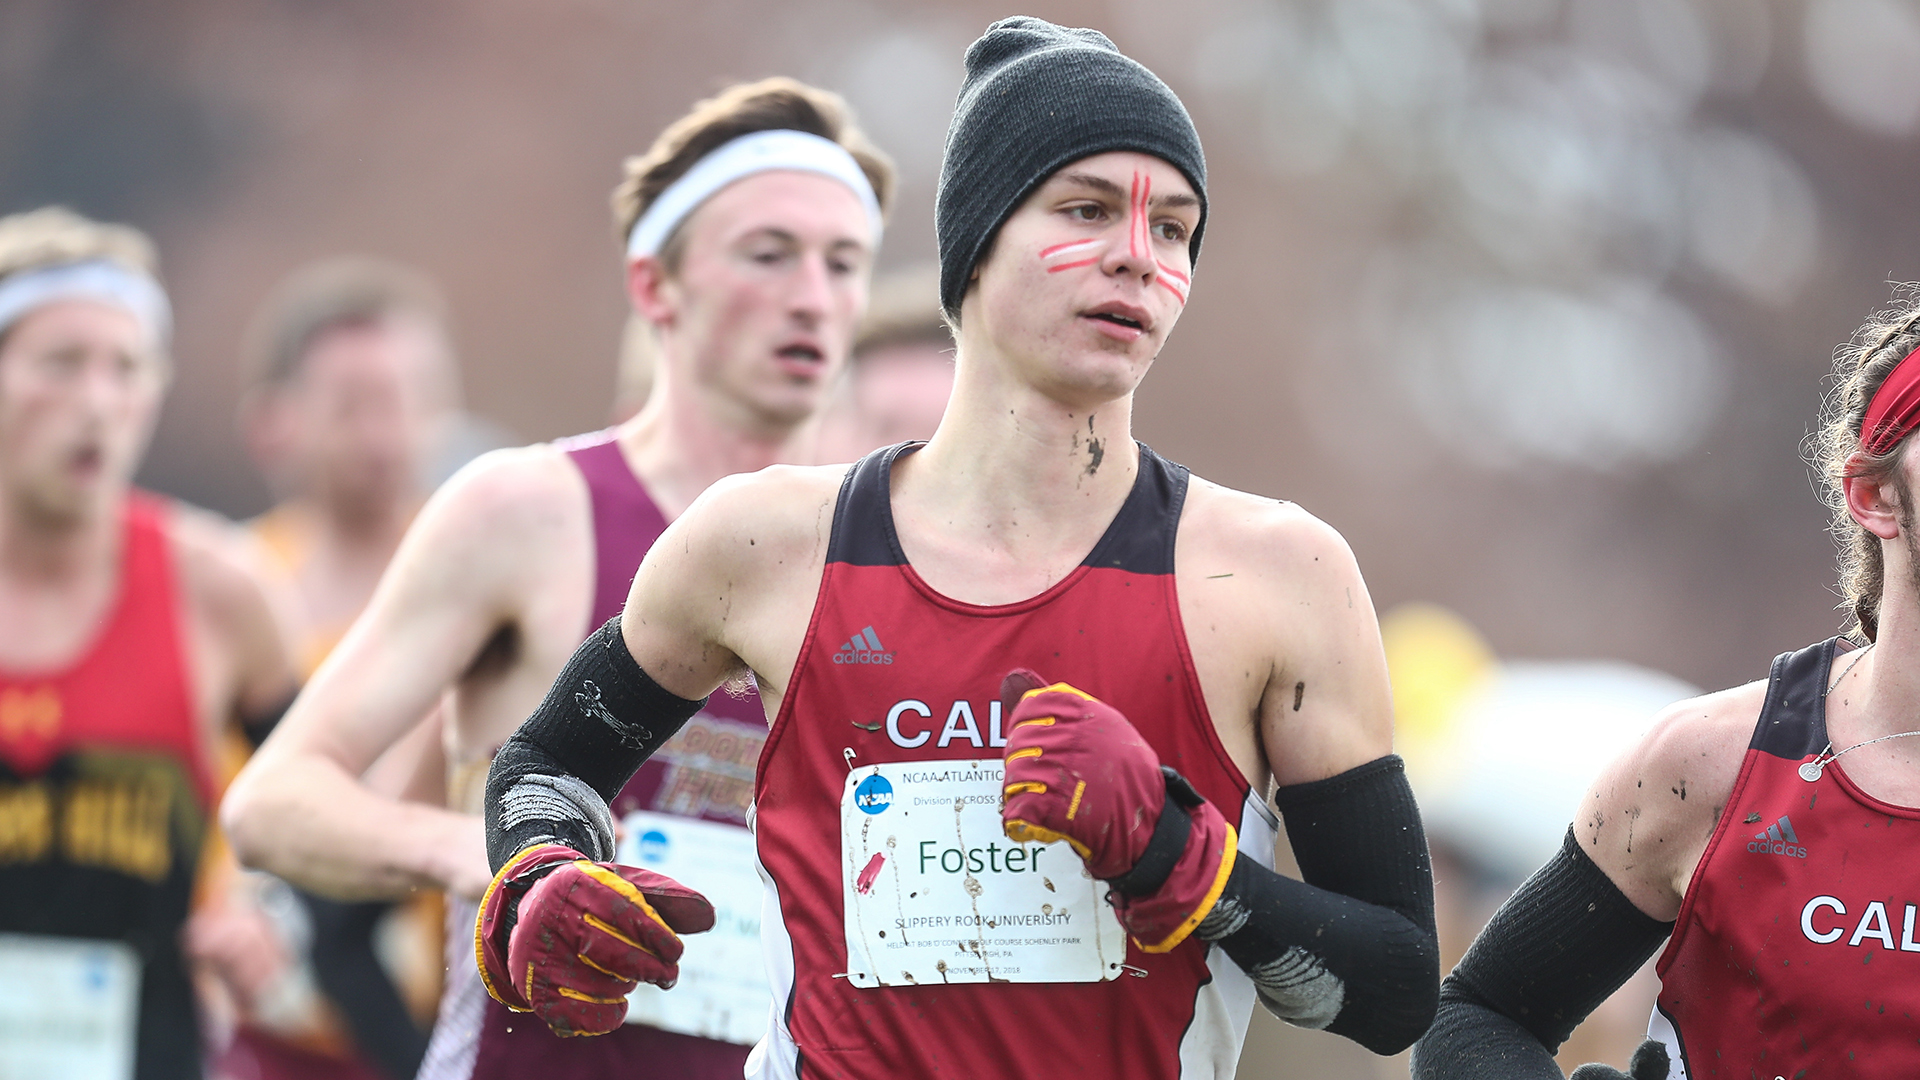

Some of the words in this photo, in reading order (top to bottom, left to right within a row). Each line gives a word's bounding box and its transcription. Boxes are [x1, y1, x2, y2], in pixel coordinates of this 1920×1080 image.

[833, 650, 894, 665] adidas
[885, 699, 1009, 749] CAL
[902, 772, 939, 784] NCAA
[942, 770, 1004, 783] ATLANTIC
[858, 792, 893, 807] NCAA
[914, 796, 952, 806] Division
[963, 795, 996, 805] CROSS
[919, 840, 1046, 874] Foster
[1747, 840, 1807, 859] adidas
[895, 916, 951, 929] SLIPPERY
[955, 915, 989, 927] ROCK
[993, 914, 1071, 926] UNIVERISITY
[1800, 895, 1920, 953] CAL
[994, 938, 1022, 946] COURSE
[1062, 937, 1081, 945] PARK
